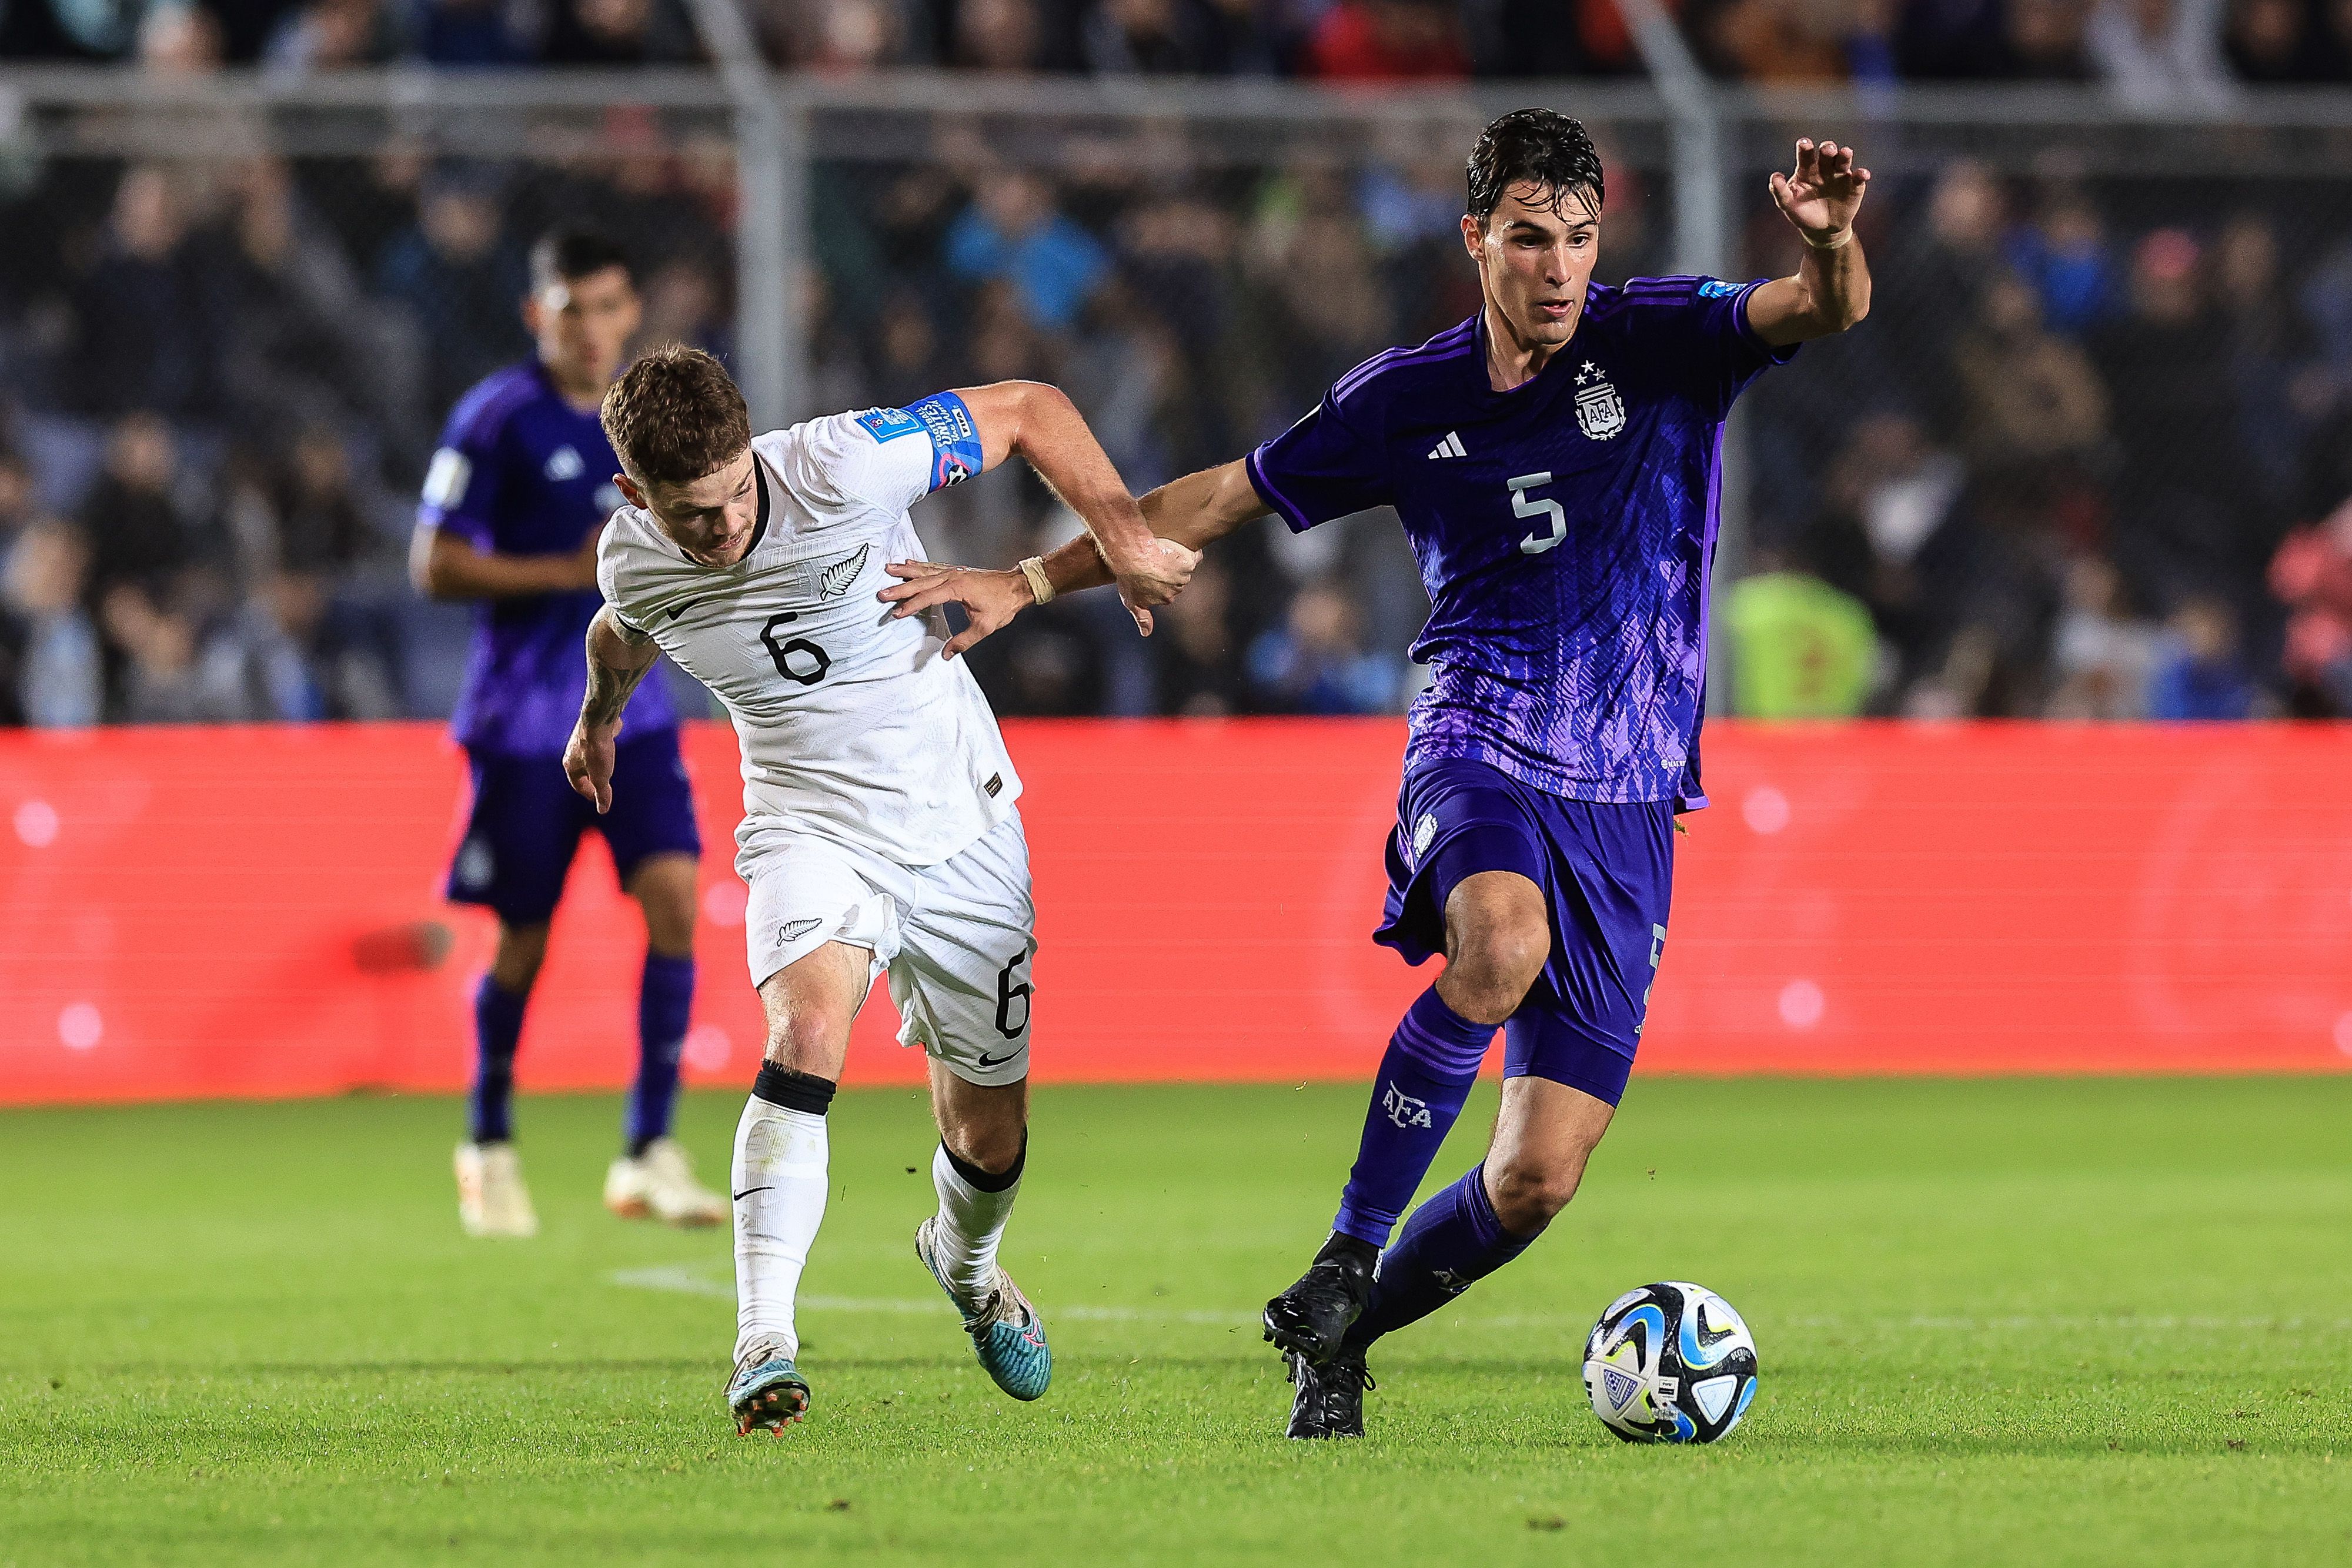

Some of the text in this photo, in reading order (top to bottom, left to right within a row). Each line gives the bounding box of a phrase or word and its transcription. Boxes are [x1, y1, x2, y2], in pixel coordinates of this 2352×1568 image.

[915, 407, 943, 448] FOOTBALL
[920, 404, 953, 445] UNITES
[956, 412, 968, 433] FIFA
[1589, 399, 1615, 424] AFA
[1507, 471, 1567, 554] 5
[760, 611, 831, 686] 6
[995, 947, 1031, 1040] 6
[1382, 1079, 1432, 1128] AFA
